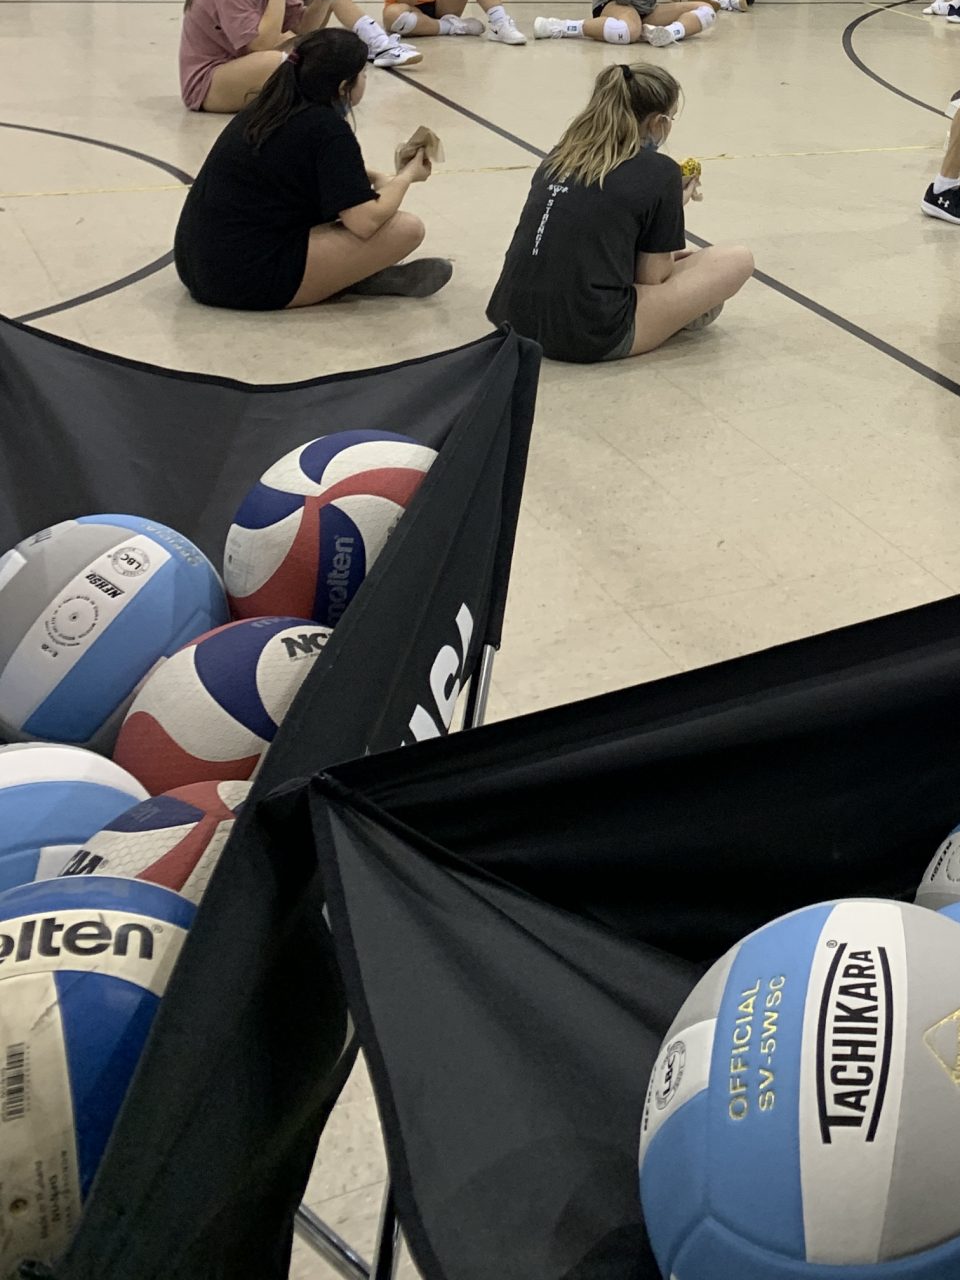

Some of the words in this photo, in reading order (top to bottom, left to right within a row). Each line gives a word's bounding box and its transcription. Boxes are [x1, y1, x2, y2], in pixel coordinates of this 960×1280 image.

[119, 553, 142, 570] LBC
[281, 632, 335, 658] NC
[0, 917, 154, 964] lten
[728, 978, 761, 1120] OFFICIAL
[823, 949, 880, 1144] TACHIKARA
